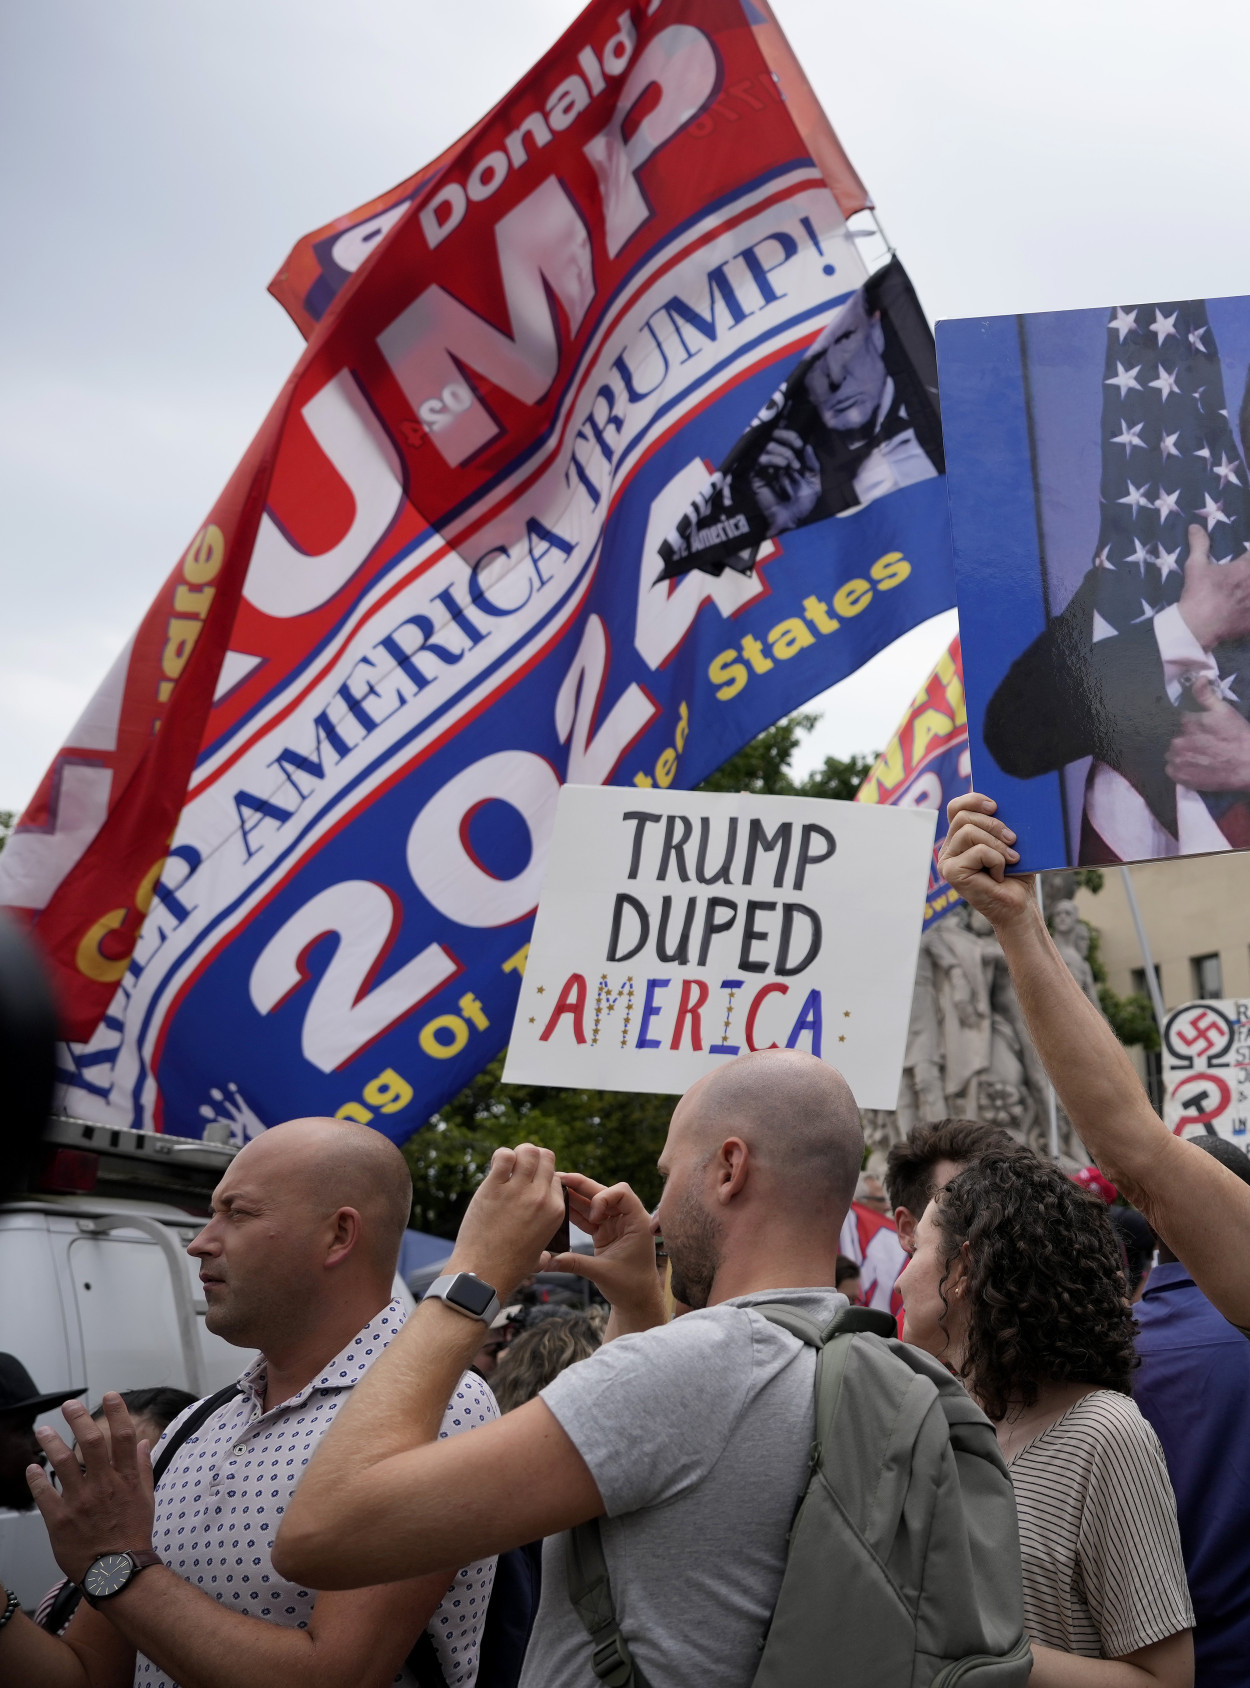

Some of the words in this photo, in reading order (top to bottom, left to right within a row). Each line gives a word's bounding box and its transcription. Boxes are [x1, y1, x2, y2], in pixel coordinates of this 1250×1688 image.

[418, 8, 640, 251] Donald
[233, 515, 579, 866] AMERICA
[564, 216, 838, 518] TRUMP!
[708, 550, 912, 702] States
[249, 457, 781, 1074] 2024
[622, 810, 838, 891] TRUMP
[606, 892, 824, 977] DUPED
[418, 991, 491, 1060] Of
[538, 972, 823, 1059] AMERICA
